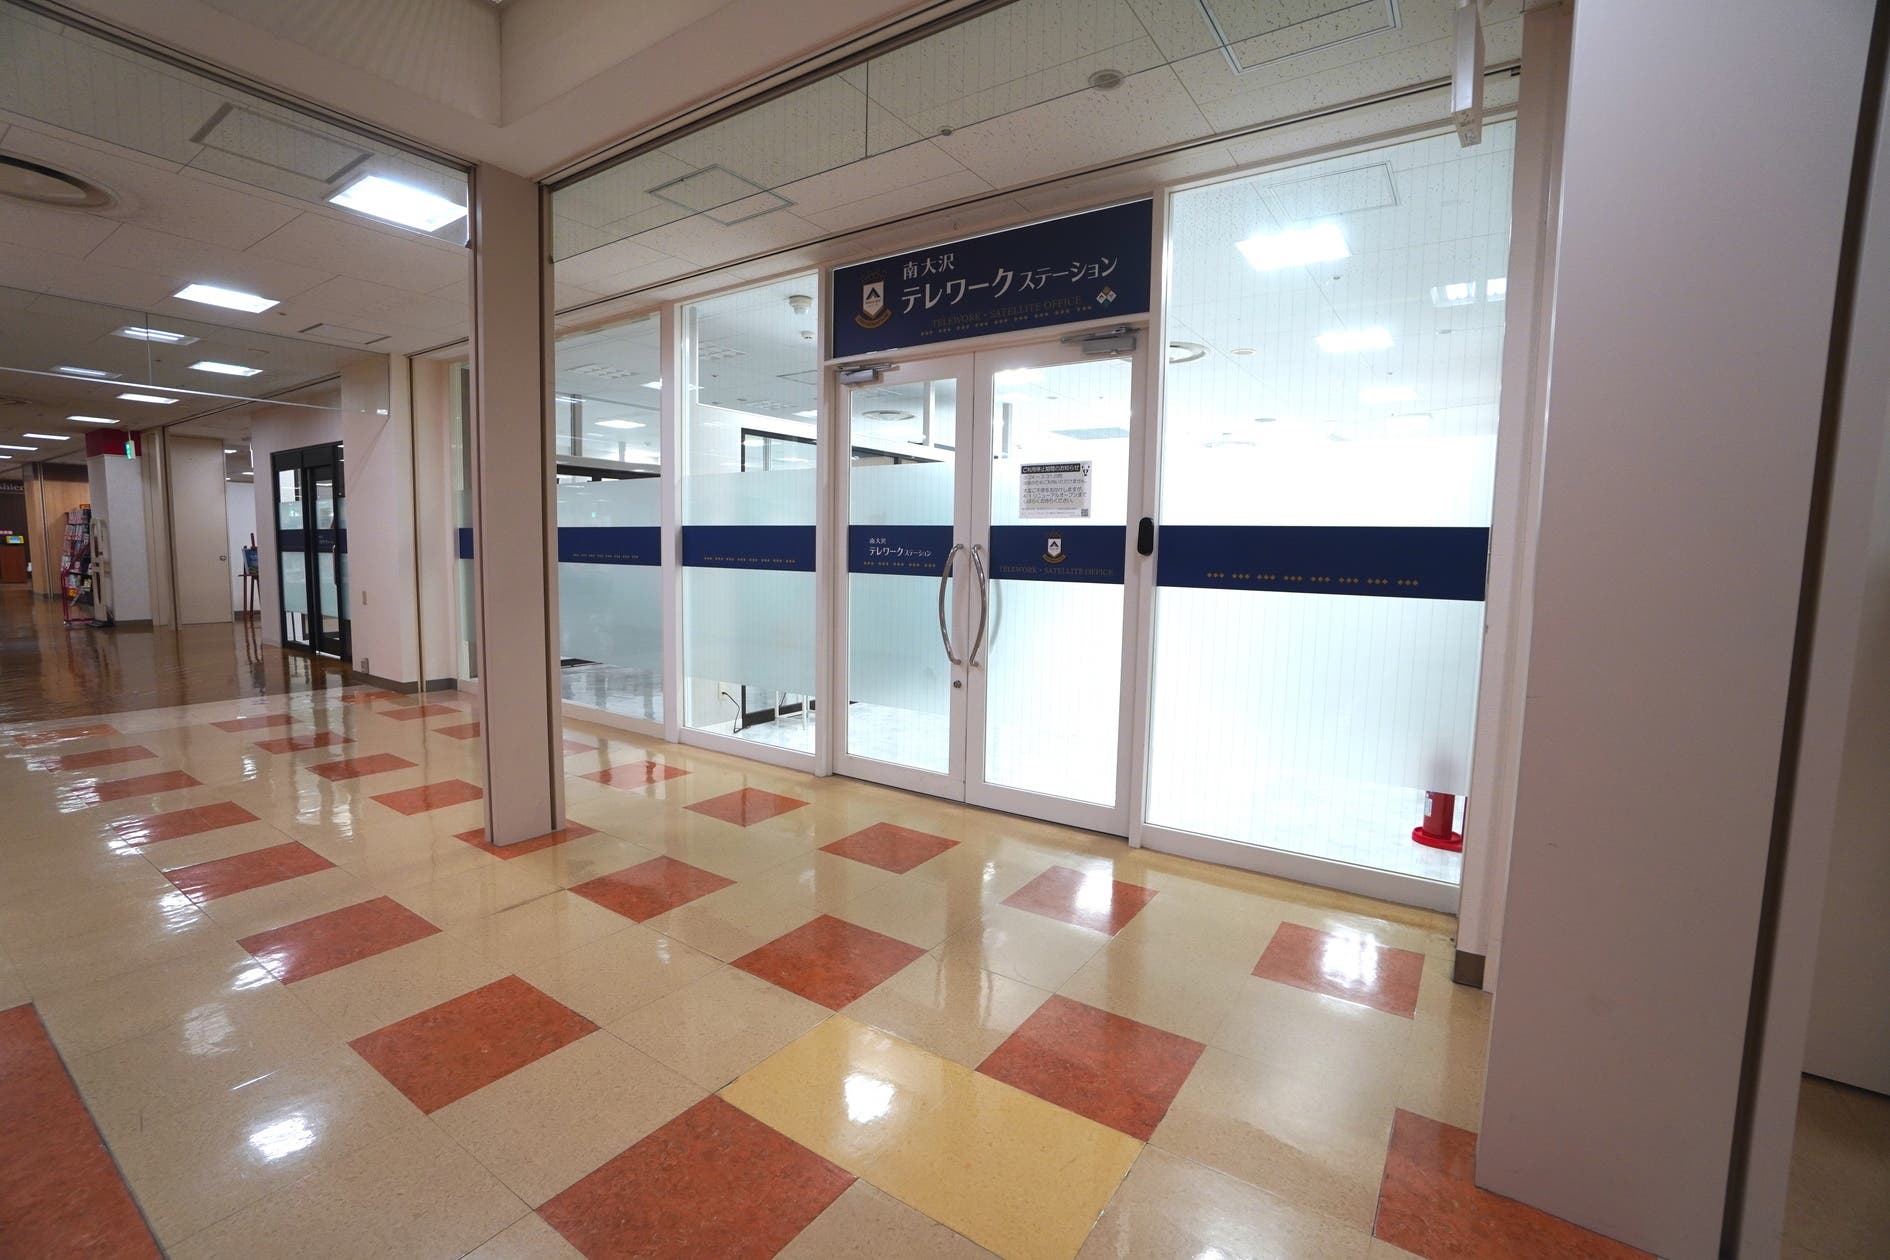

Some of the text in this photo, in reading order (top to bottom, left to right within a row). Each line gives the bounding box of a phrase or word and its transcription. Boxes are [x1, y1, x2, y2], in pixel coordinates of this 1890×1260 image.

[903, 253, 954, 280] 南大沢
[933, 295, 1082, 328] TELEWORK SATELLITE OFFICE
[869, 537, 886, 545] 南大沢
[1000, 565, 1114, 577] TELEWORK SATELLITE OFFICE
